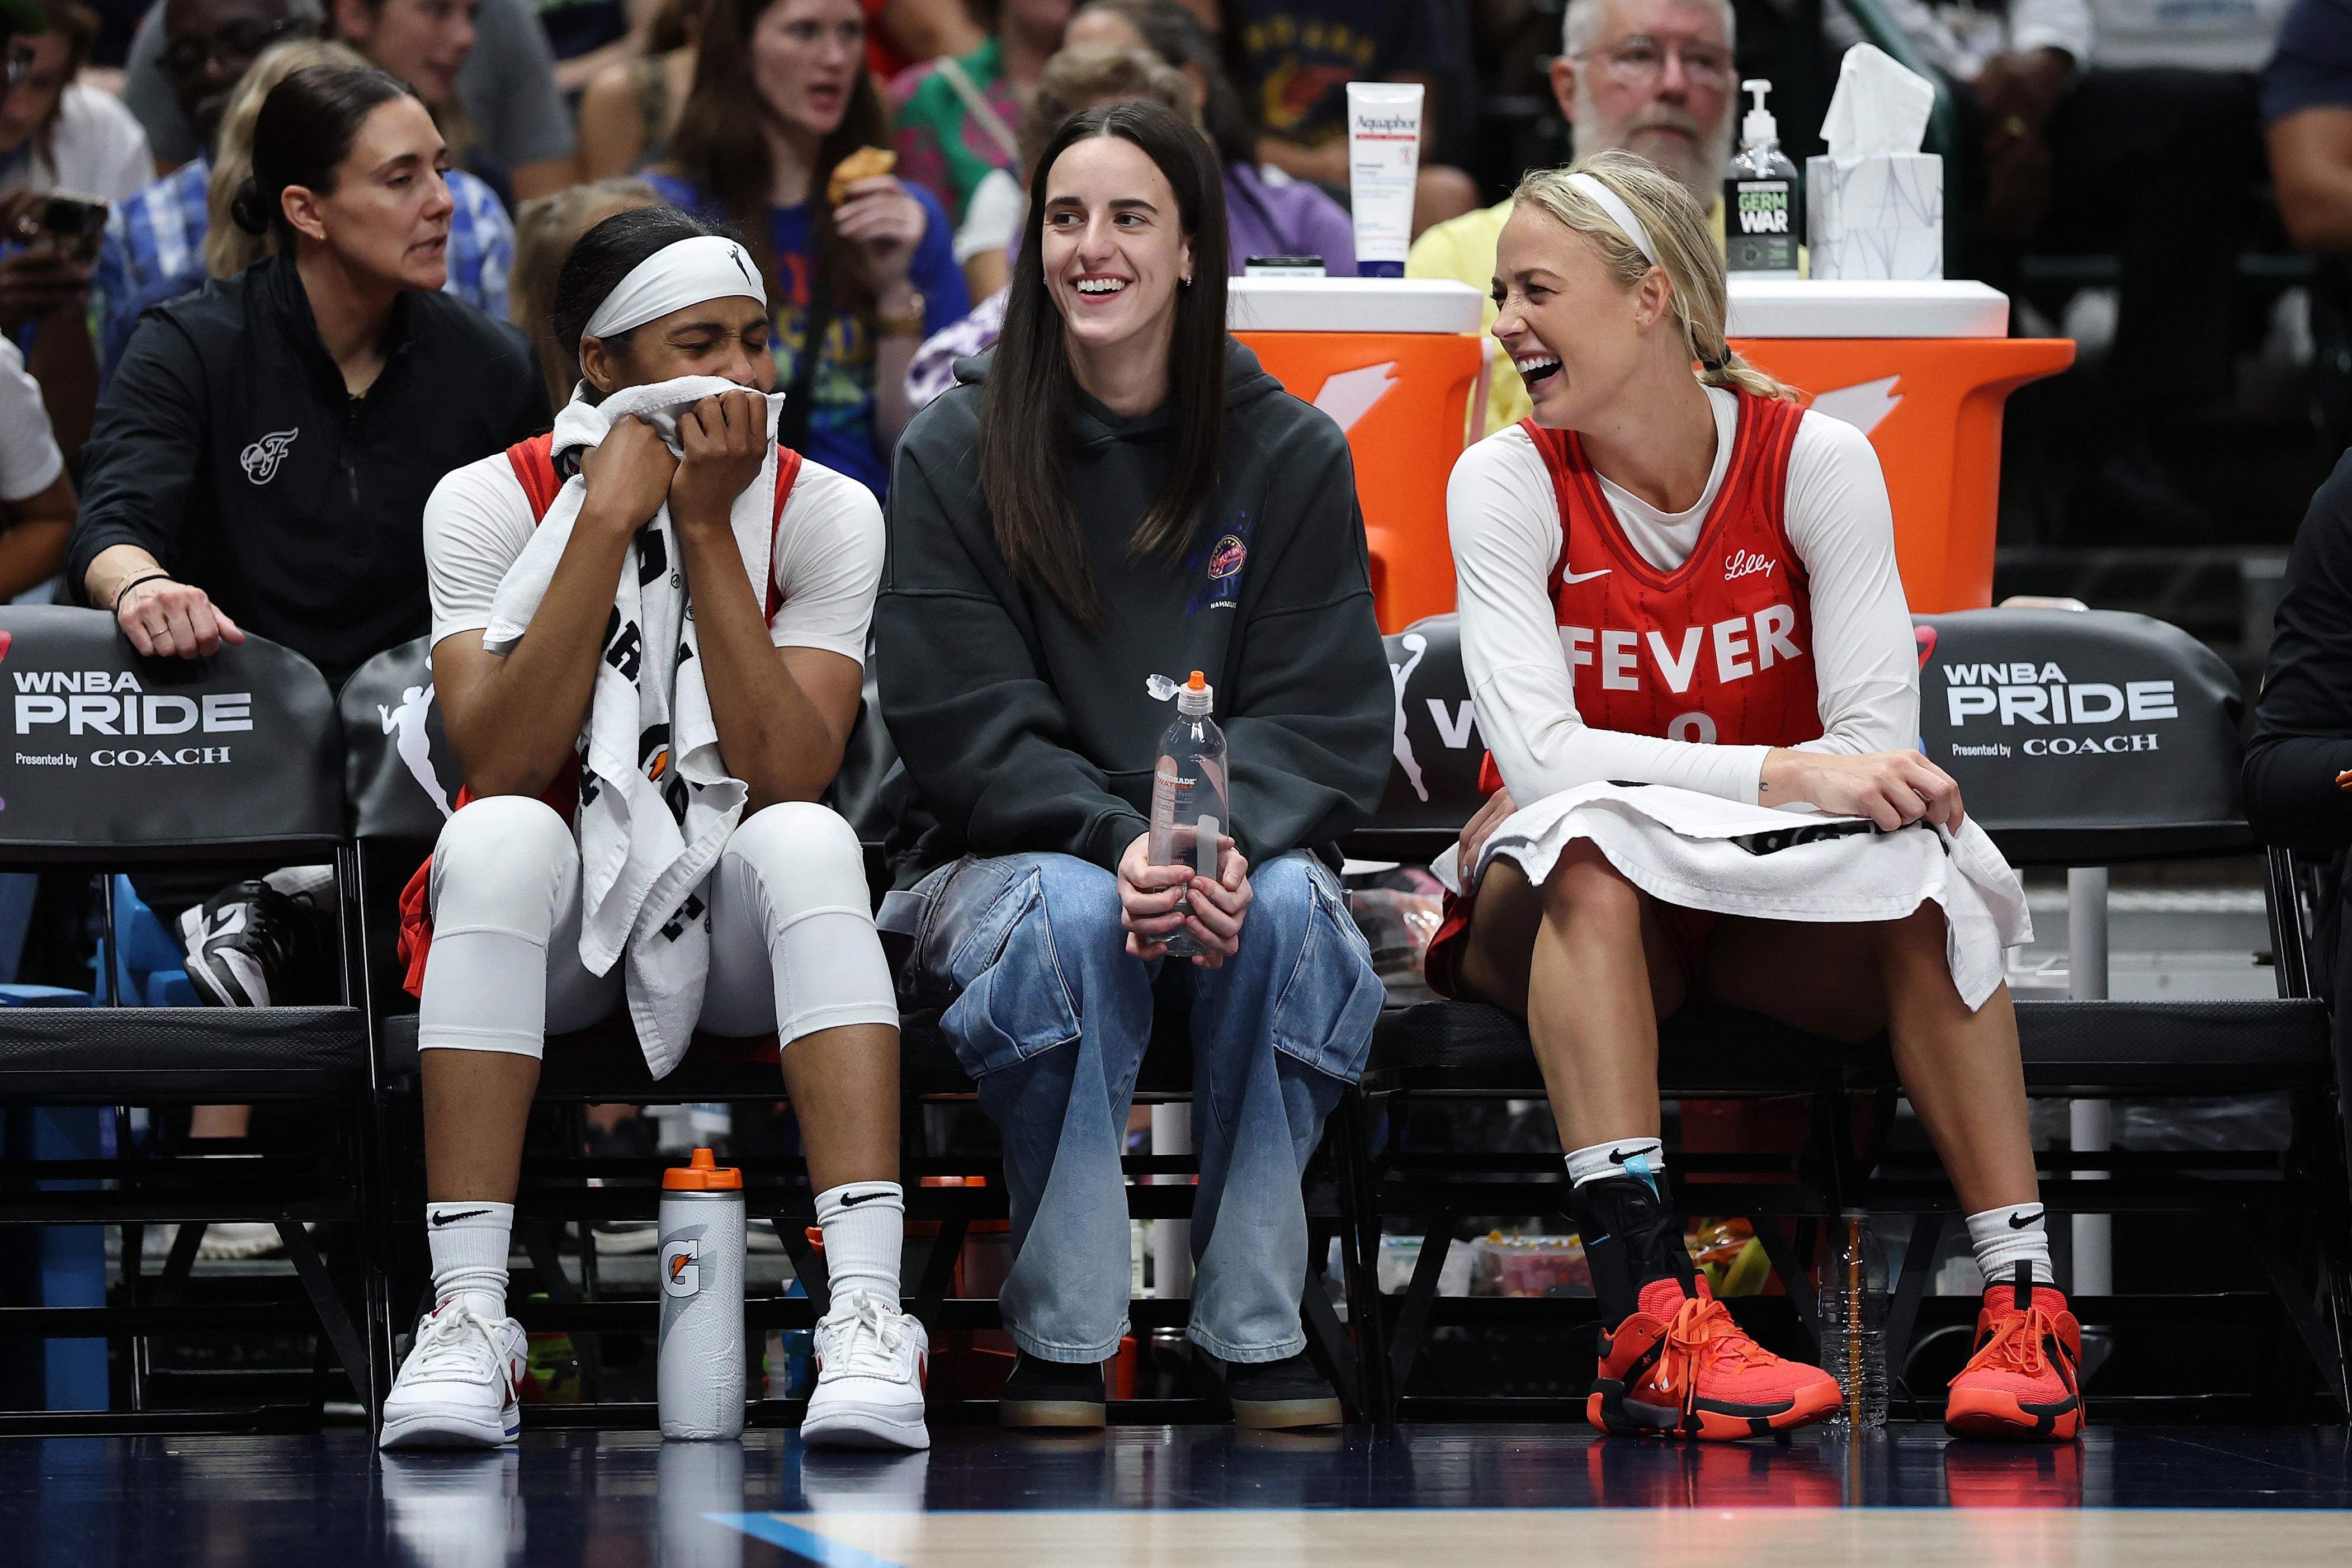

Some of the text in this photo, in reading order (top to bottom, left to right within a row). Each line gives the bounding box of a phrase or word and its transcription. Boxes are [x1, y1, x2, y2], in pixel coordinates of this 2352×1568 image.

[1356, 115, 1416, 134] Aquaphor
[1738, 192, 1788, 211] GERM
[1739, 209, 1788, 233] WAR
[1724, 549, 1777, 581] Lilly
[1558, 604, 1803, 694] FEVER
[13, 671, 143, 693] WNBA
[1943, 662, 2068, 685] WNBA
[15, 692, 254, 736] PRIDE
[1946, 680, 2179, 726] PRIDE
[15, 747, 232, 768] Presented by COACH
[1951, 733, 2159, 758] Presented by COACH
[1157, 777, 1189, 790] WATER
[660, 1239, 701, 1298] G
